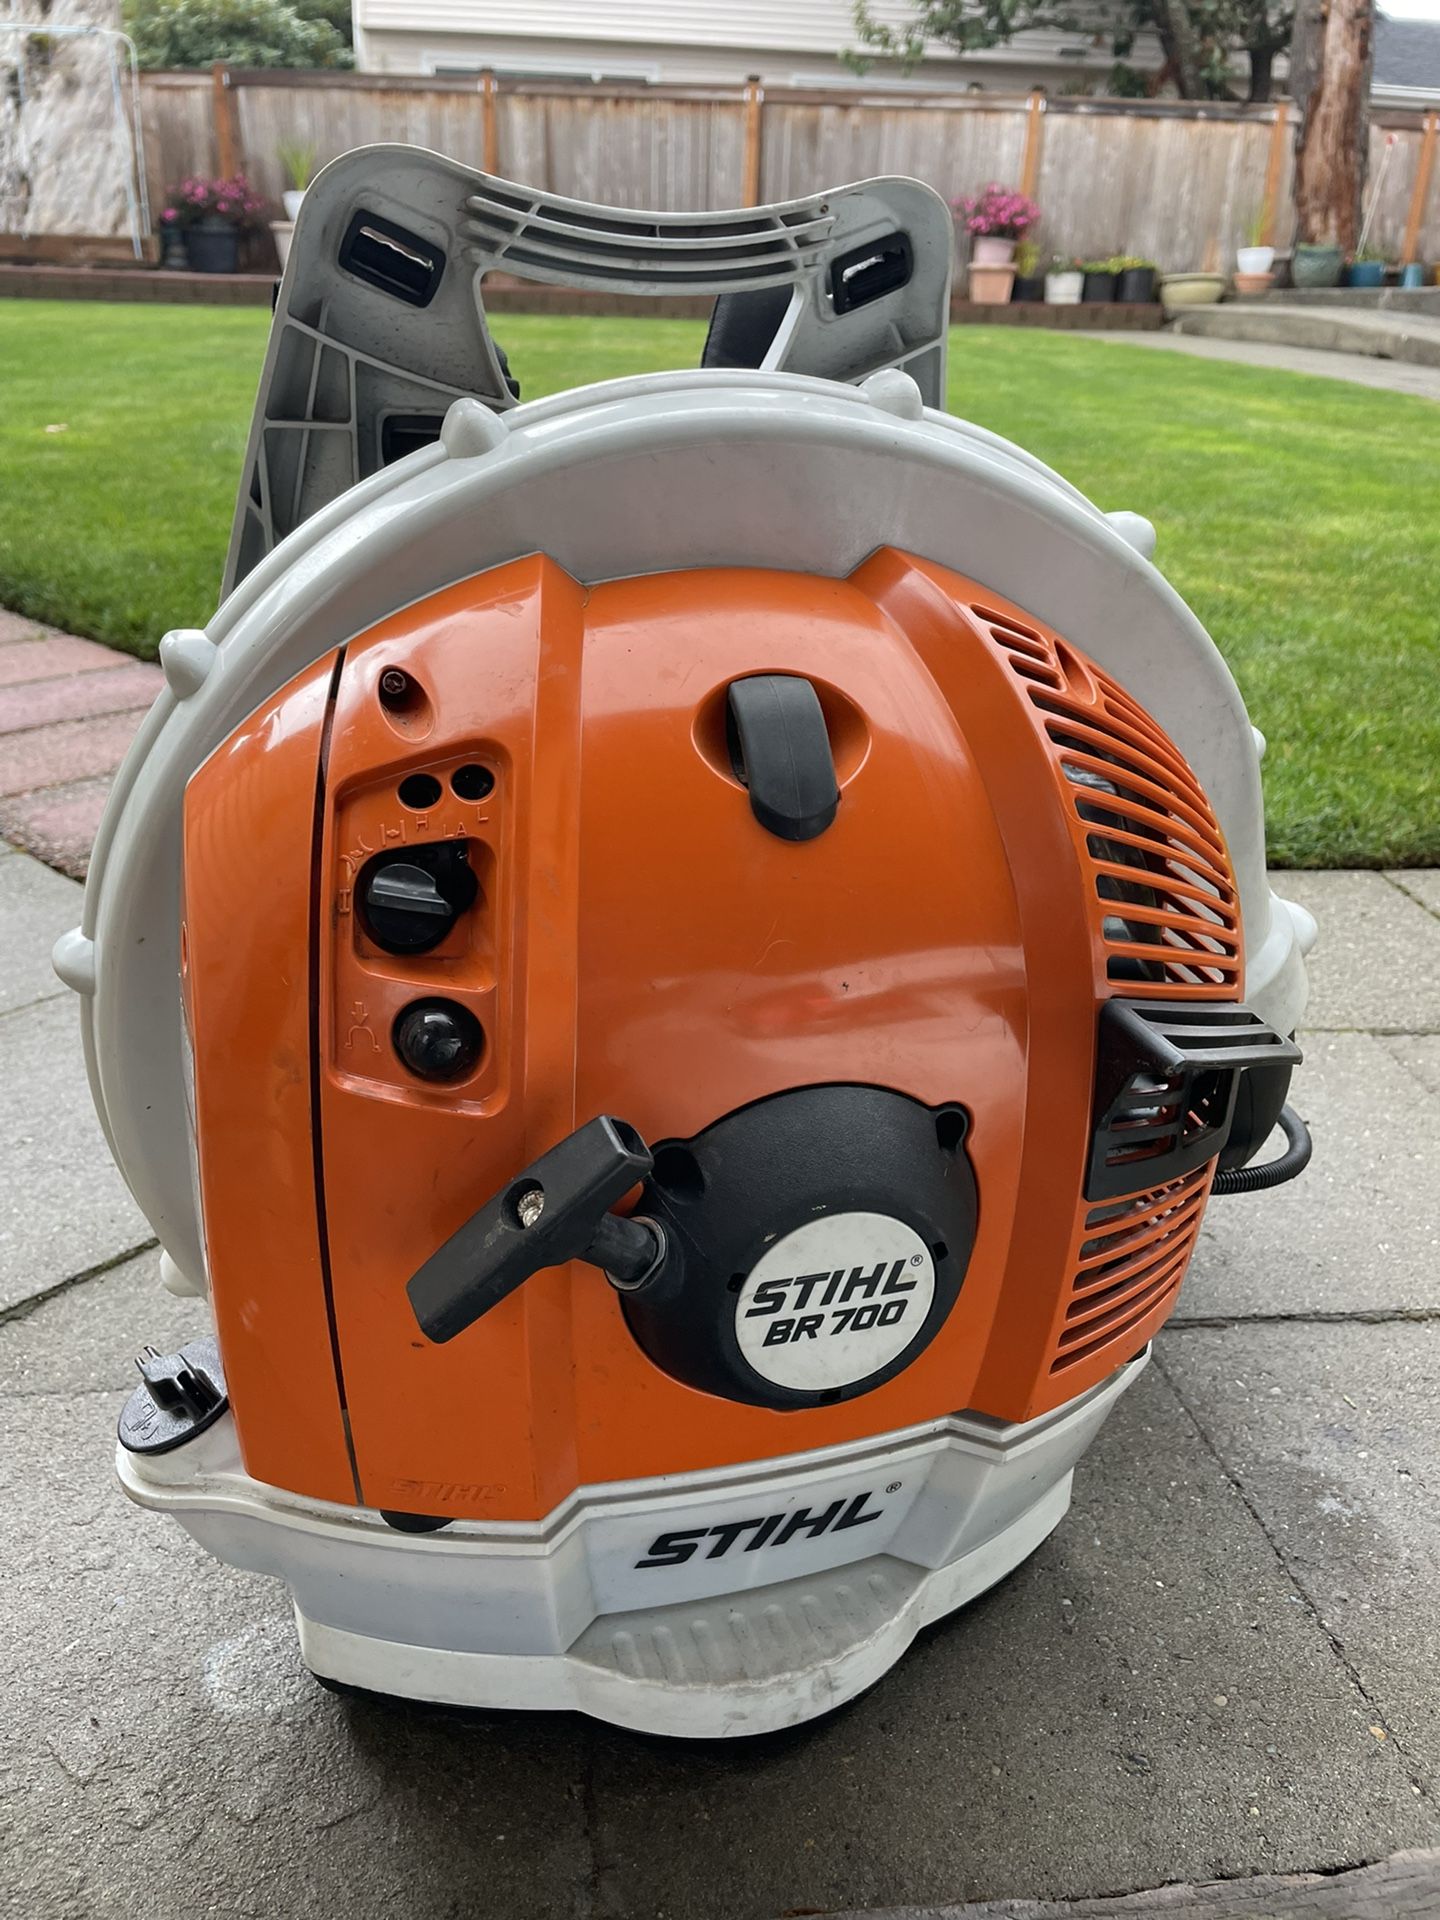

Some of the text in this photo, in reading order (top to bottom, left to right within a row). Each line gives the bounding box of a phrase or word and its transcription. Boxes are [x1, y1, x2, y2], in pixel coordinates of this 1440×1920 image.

[477, 806, 489, 822] L
[415, 814, 429, 832] H
[443, 822, 467, 837] LA
[762, 1299, 908, 1347] BR 700
